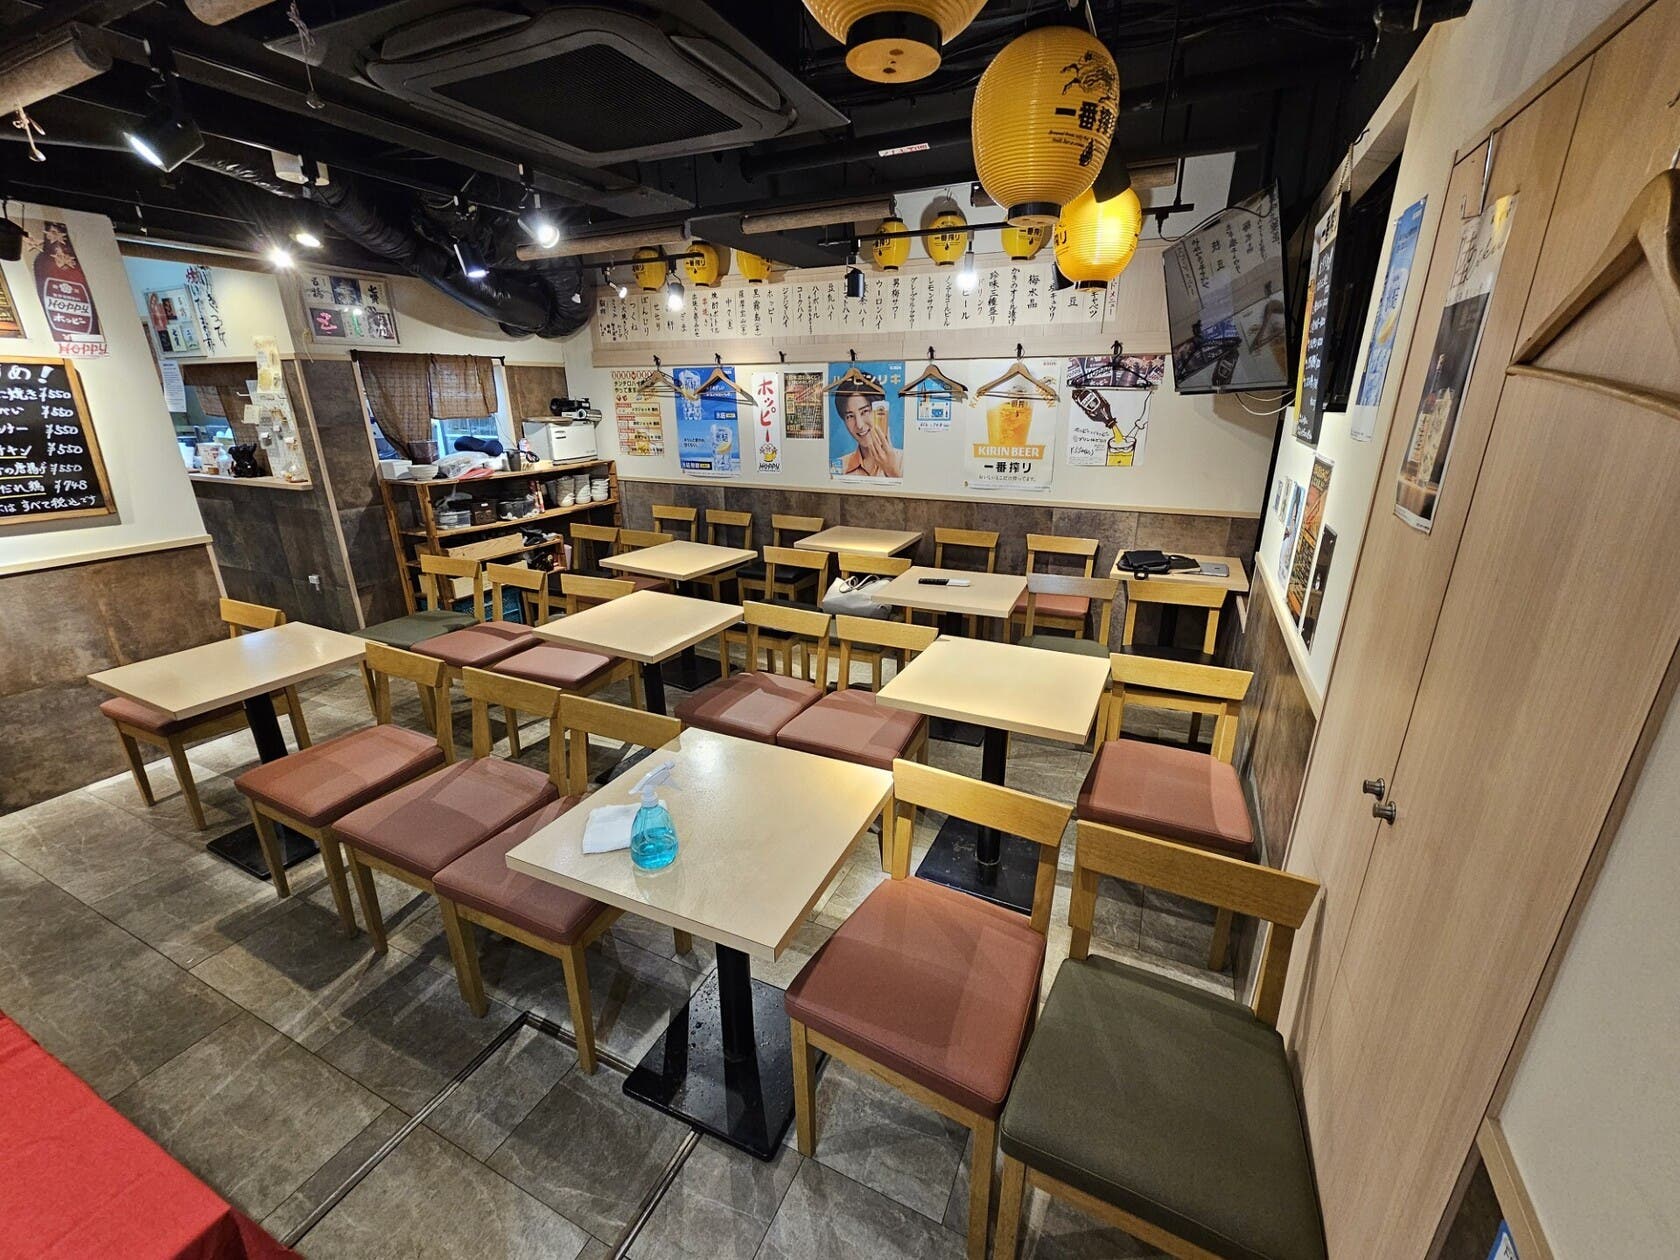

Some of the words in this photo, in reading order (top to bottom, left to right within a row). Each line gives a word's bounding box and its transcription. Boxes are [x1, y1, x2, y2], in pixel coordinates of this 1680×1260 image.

[927, 276, 935, 320] レモンサワー
[1027, 274, 1040, 310] 梅水晶
[767, 289, 775, 325] ホッピー
[812, 285, 820, 319] ハイボール
[827, 283, 835, 321] 豆乳ハイ
[875, 280, 883, 330] ウーロンハイ
[52, 312, 87, 326] ホッピー
[641, 296, 650, 336] ぼんじり
[38, 386, 72, 402] ¥550
[41, 405, 75, 419] ¥550
[758, 376, 777, 443] ホッピー
[45, 423, 79, 439] ¥550
[47, 441, 84, 457] ¥550
[978, 445, 1010, 457] KIRIN
[1011, 446, 1040, 458] BEER
[50, 462, 83, 476] ¥550
[984, 462, 1032, 474] 一番搾り
[54, 479, 89, 494] ¥748
[21, 494, 97, 512] すべて税込です
